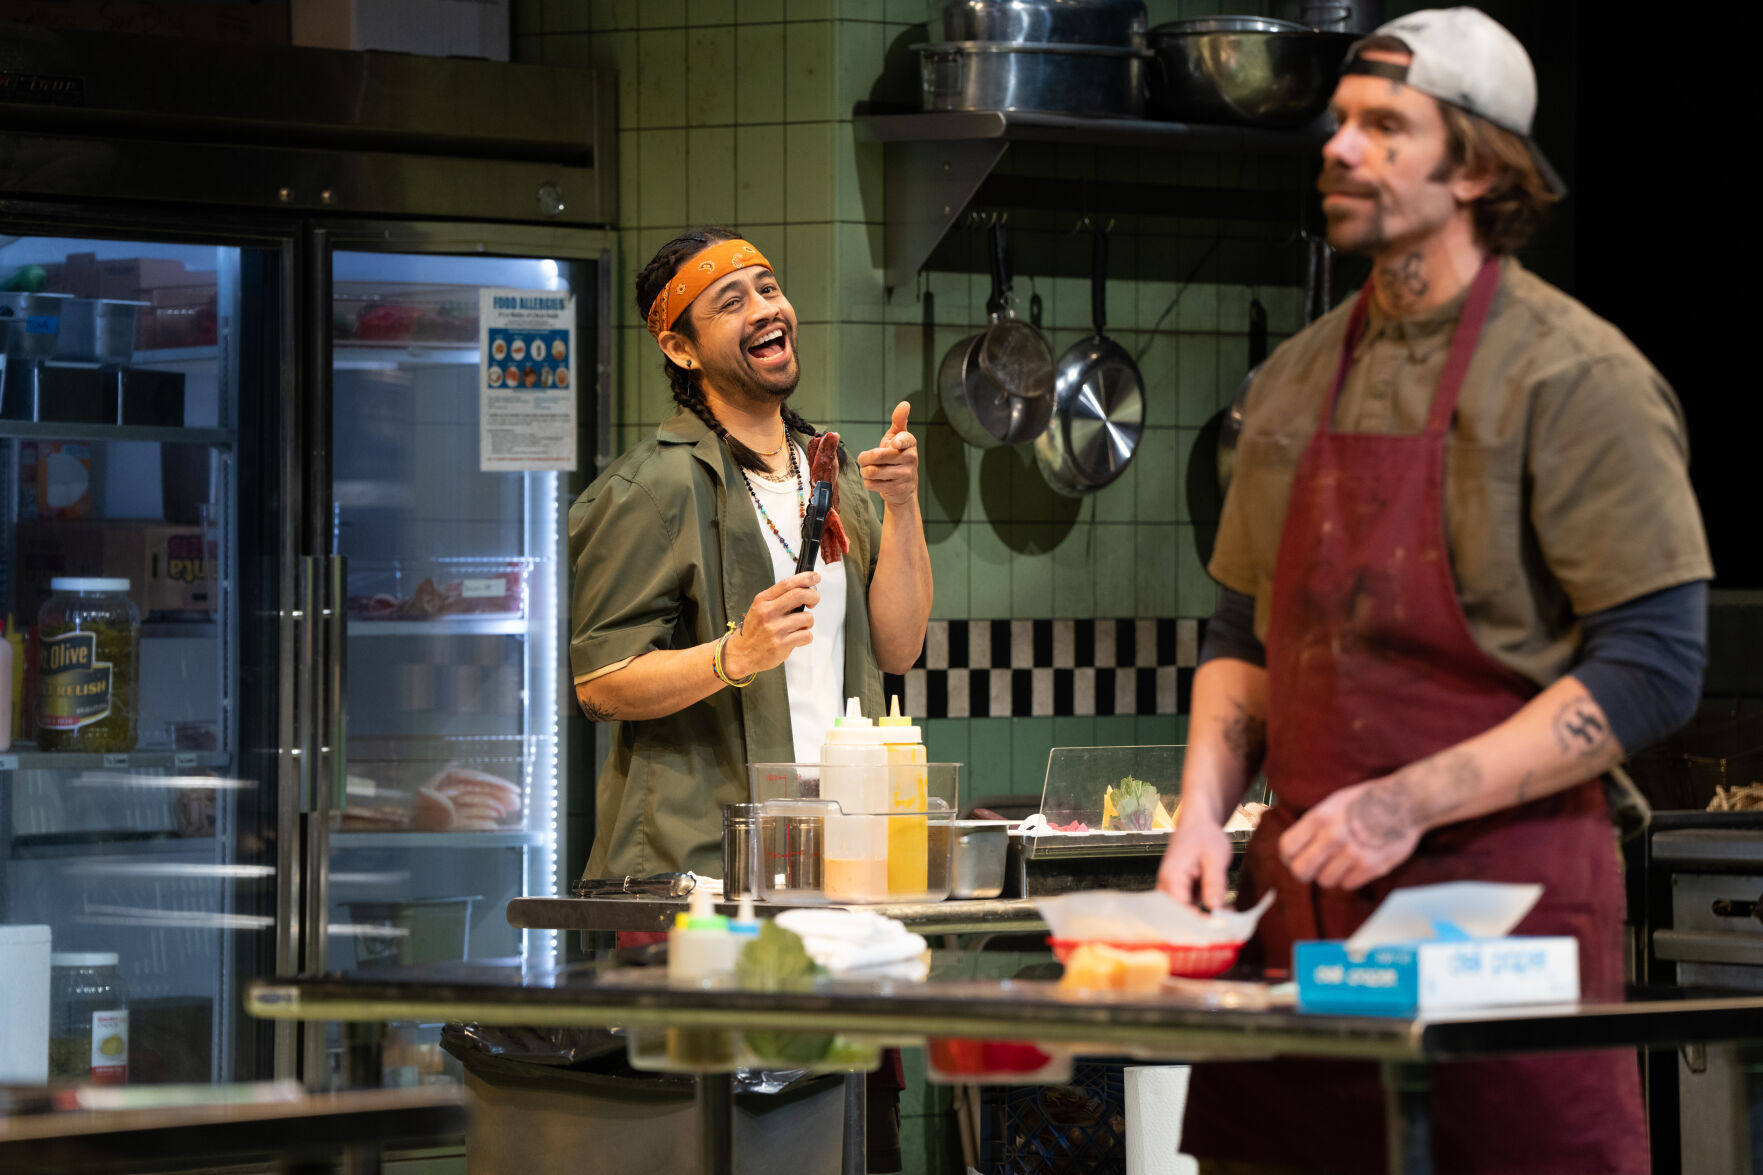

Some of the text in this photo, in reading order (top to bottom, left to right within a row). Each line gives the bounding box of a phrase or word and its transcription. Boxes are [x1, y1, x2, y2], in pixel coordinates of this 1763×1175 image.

[493, 296, 565, 310] FOOD ALLERGIES
[50, 643, 89, 669] Olive
[57, 680, 106, 697] RELISH
